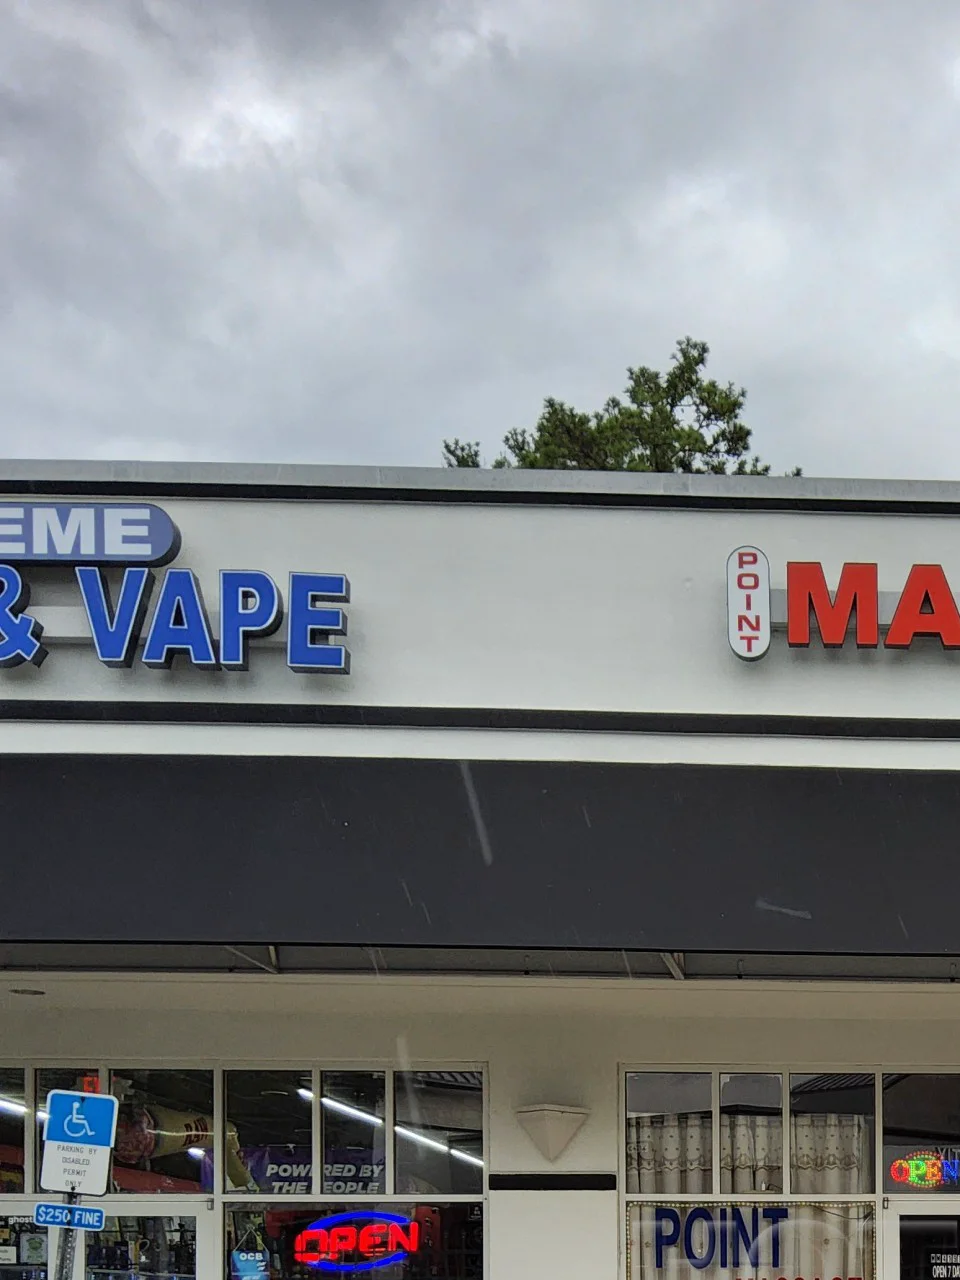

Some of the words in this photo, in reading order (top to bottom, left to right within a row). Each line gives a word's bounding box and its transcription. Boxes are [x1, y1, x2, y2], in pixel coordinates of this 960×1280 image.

[737, 552, 758, 653] POINT
[76, 566, 349, 673] VAPE
[57, 1144, 84, 1154] PARKING
[88, 1147, 97, 1155] BY
[62, 1156, 90, 1166] DISABLED
[63, 1168, 86, 1177] PERMIT
[266, 1164, 356, 1177] POWRED
[359, 1164, 384, 1177] BY
[890, 1159, 960, 1182] OPEN
[65, 1179, 82, 1188] ONLY
[271, 1181, 308, 1194] THE
[312, 1181, 380, 1194] EOPLE
[38, 1205, 70, 1223] $250
[74, 1210, 101, 1226] FINE
[294, 1221, 419, 1263] OPEN
[655, 1207, 789, 1269] POINT
[239, 1252, 263, 1261] OCB
[932, 1265, 947, 1278] OPEN
